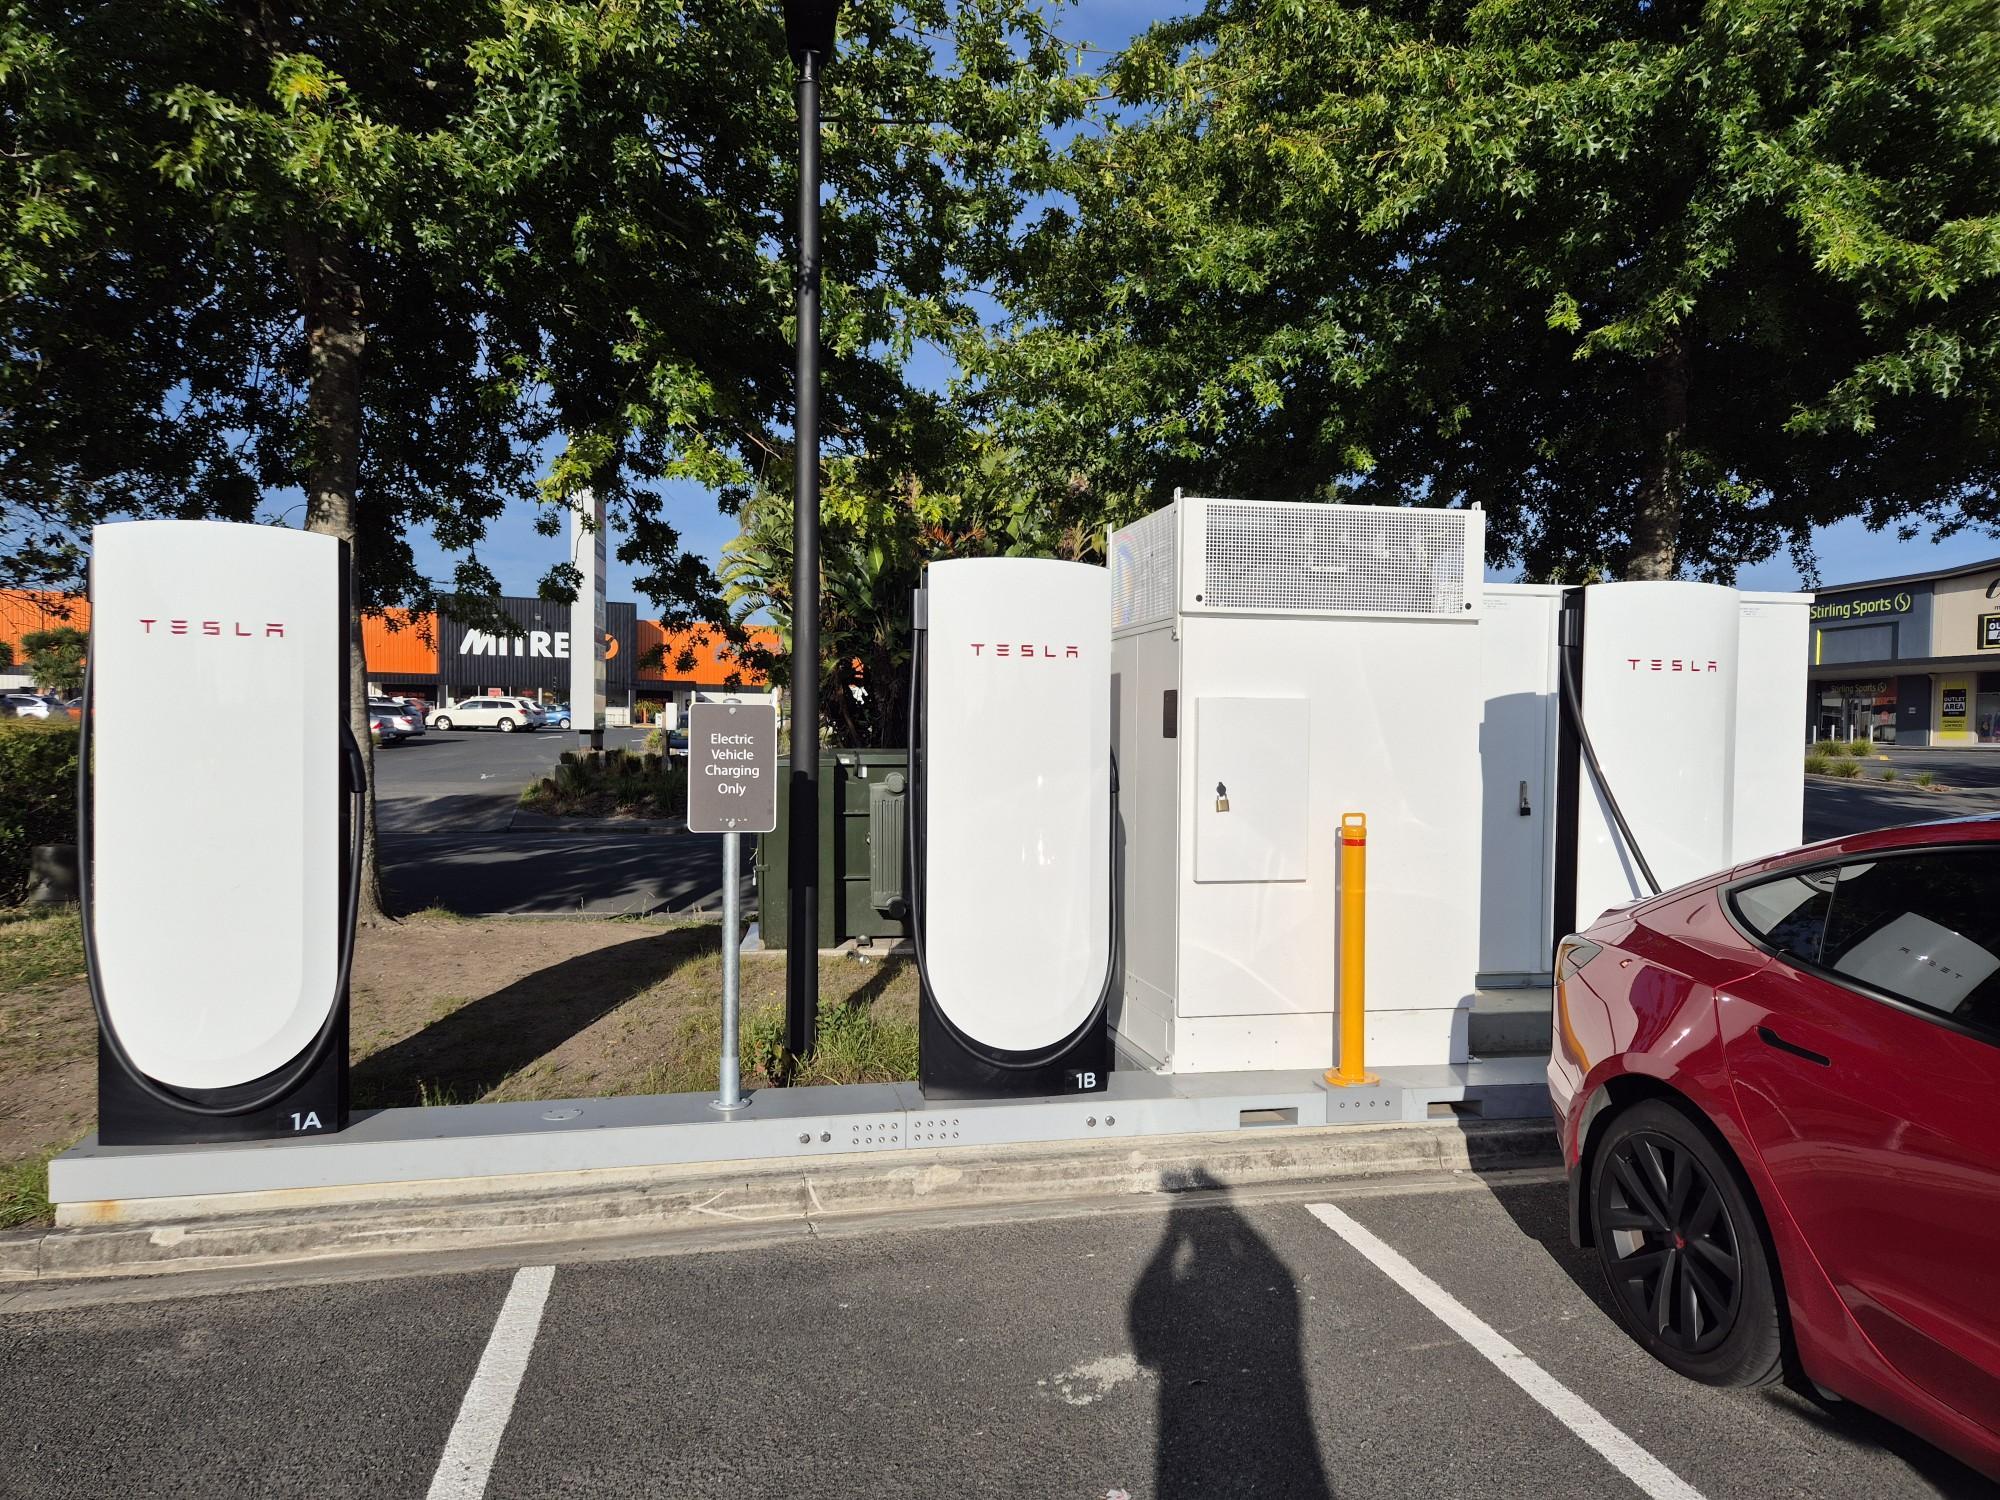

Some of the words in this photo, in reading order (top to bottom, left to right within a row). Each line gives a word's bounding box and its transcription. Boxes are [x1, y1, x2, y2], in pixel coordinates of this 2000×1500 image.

[1810, 604, 1850, 619] Stirling
[1853, 598, 1892, 616] Sports
[139, 619, 284, 638] TESLA
[970, 643, 1078, 658] TESLA
[1627, 658, 1718, 672] TESLA
[710, 733, 754, 745] Electric
[711, 749, 754, 760] Vehicle
[705, 764, 760, 779] Charging
[717, 783, 747, 797] Only
[1075, 1072, 1097, 1089] 1B
[290, 1111, 323, 1131] 1A
